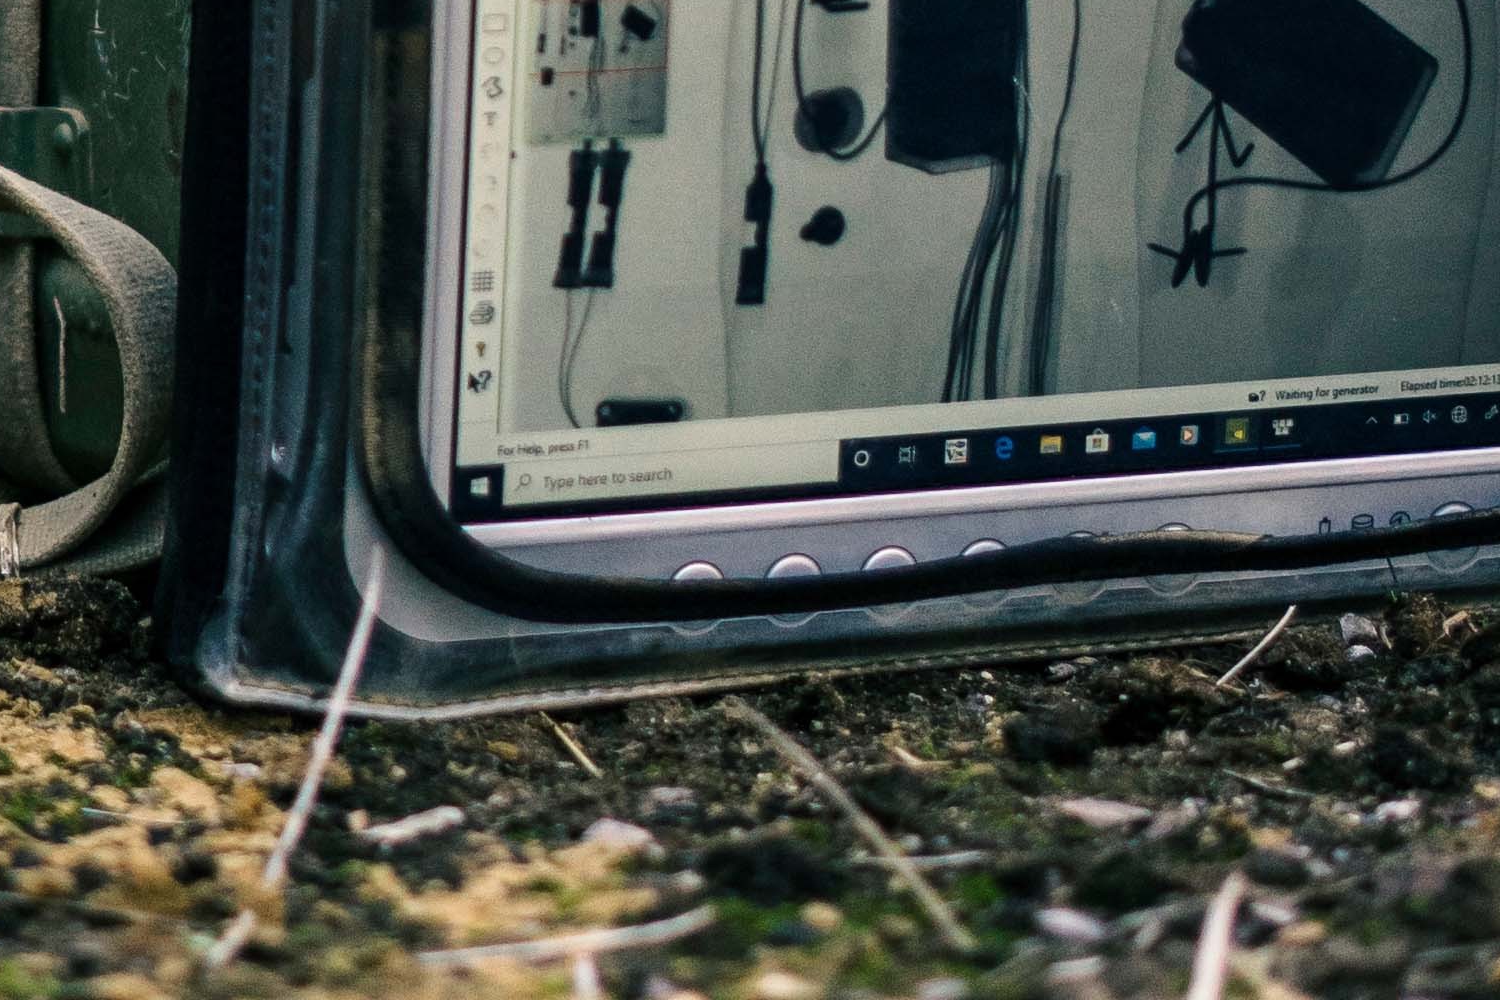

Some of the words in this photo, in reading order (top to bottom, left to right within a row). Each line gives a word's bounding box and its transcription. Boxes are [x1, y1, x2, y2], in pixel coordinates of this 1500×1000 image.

[1275, 389, 1314, 401] Waiting
[1315, 386, 1330, 397] for
[1332, 385, 1380, 399] generator
[1400, 379, 1438, 392] Elapsed
[497, 445, 515, 456] For
[517, 443, 545, 456] Help,
[548, 444, 575, 455] press
[577, 439, 590, 451] F1
[544, 475, 575, 490] Type
[578, 472, 608, 486] here
[611, 471, 627, 483] to
[628, 467, 673, 482] search
